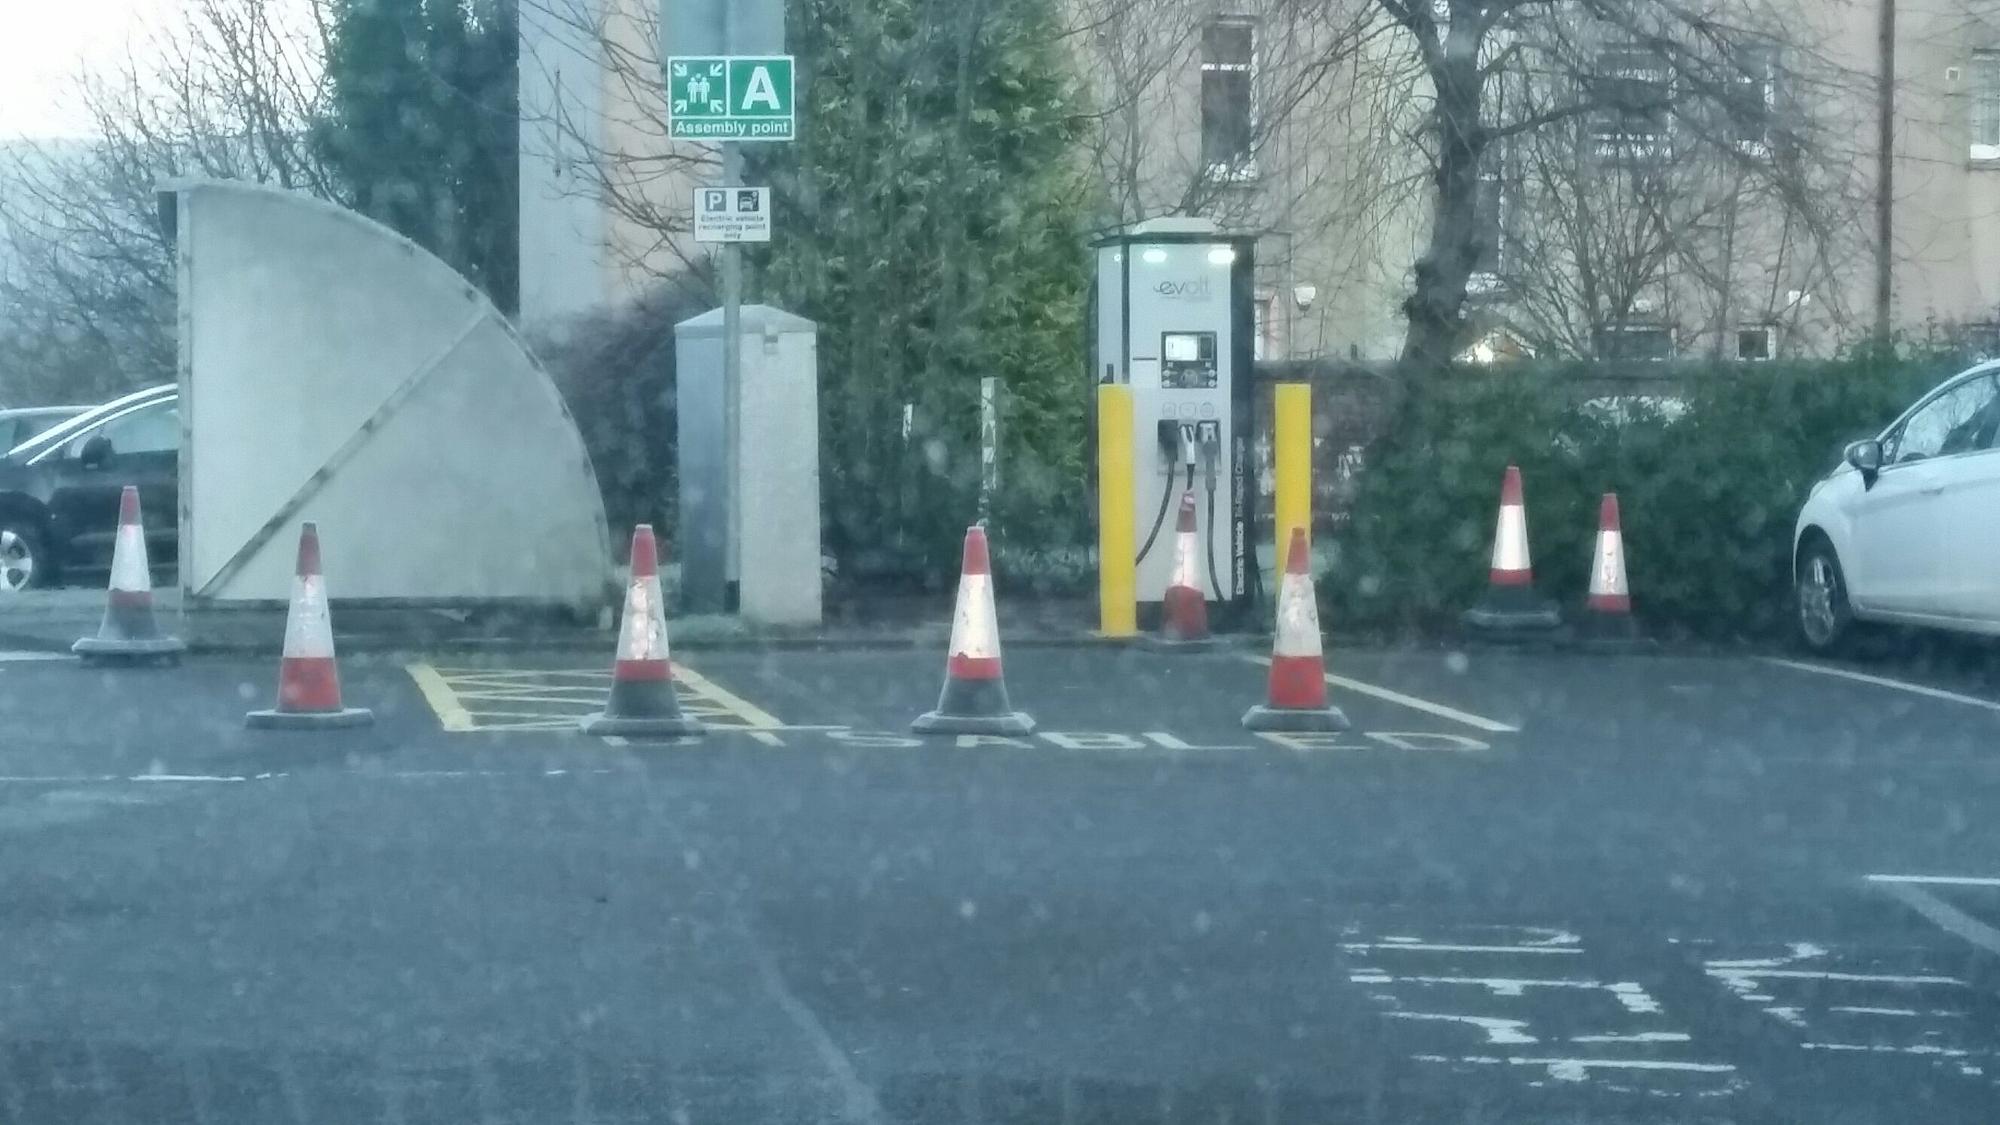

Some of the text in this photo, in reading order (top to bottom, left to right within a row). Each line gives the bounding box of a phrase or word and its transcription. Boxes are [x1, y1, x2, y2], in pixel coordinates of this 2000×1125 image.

[741, 65, 781, 110] A
[674, 121, 788, 136] Assembly point
[709, 192, 723, 210] P
